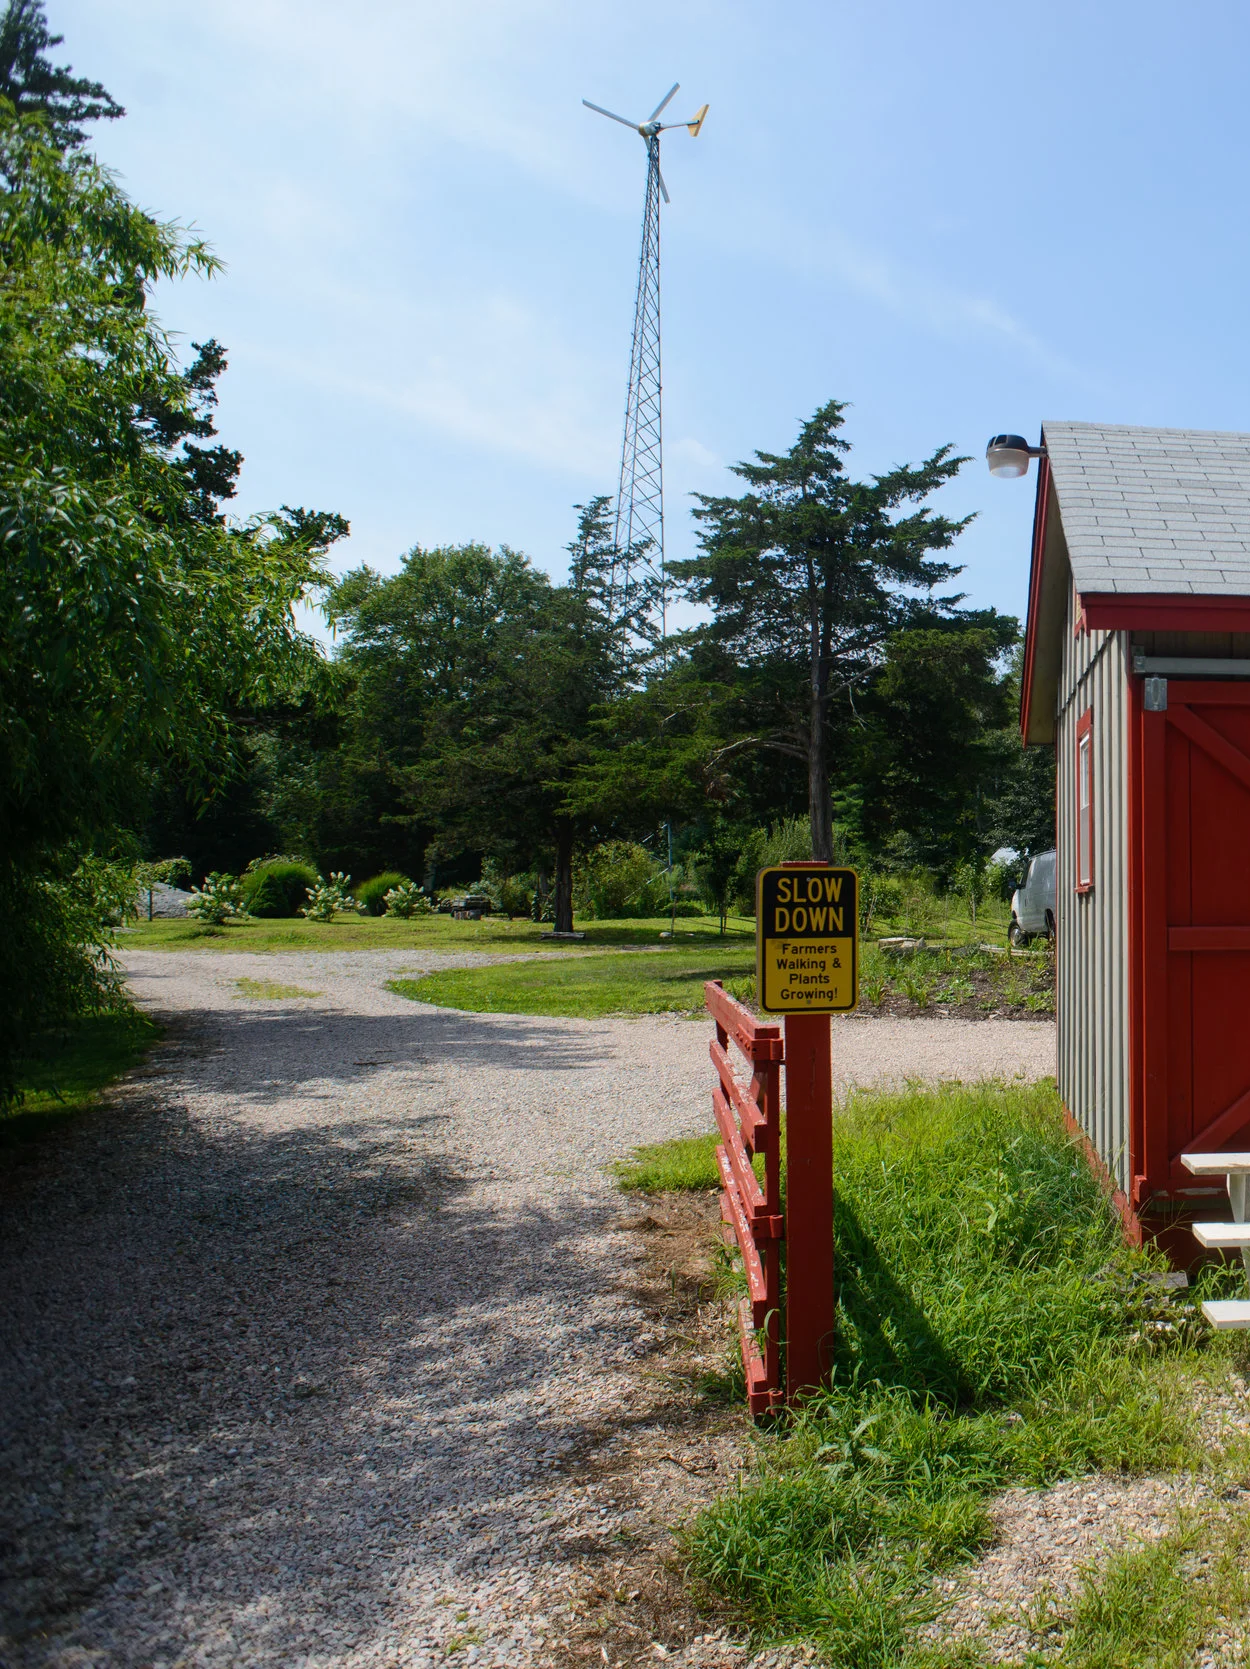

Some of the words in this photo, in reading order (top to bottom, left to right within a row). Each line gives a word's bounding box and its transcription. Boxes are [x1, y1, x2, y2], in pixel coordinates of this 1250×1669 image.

[777, 877, 842, 902] SLOW
[776, 906, 843, 932] DOWN
[782, 943, 837, 954] Farmers
[776, 959, 826, 971] Walking
[832, 958, 841, 969] &
[789, 974, 830, 984] Plants
[780, 988, 838, 1001] Growing!
